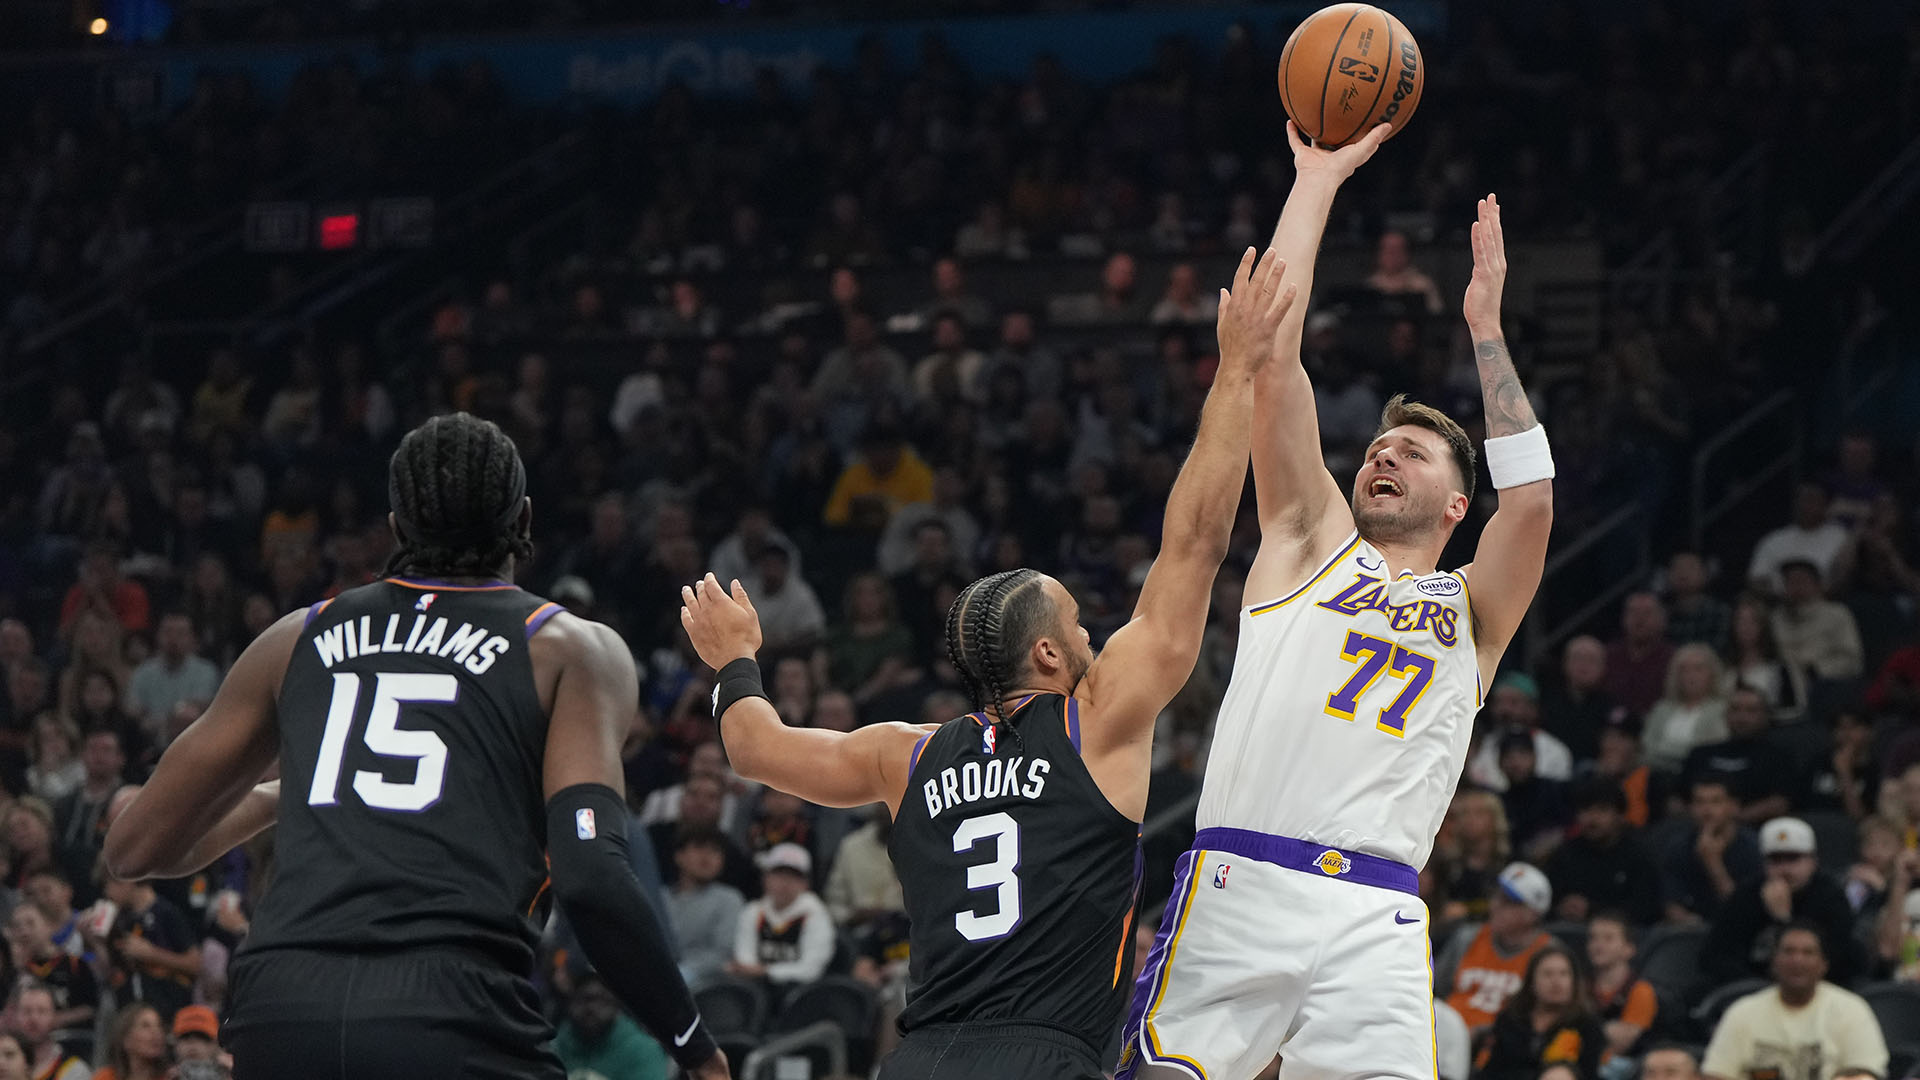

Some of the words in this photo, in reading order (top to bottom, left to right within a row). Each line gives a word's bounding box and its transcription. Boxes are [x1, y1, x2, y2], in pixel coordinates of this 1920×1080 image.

[1420, 581, 1458, 591] bibigo
[313, 613, 510, 675] WILLIAMS
[1323, 628, 1438, 739] 77
[307, 672, 459, 813] 15
[923, 756, 1051, 819] BROOKS
[952, 811, 1022, 942] 3
